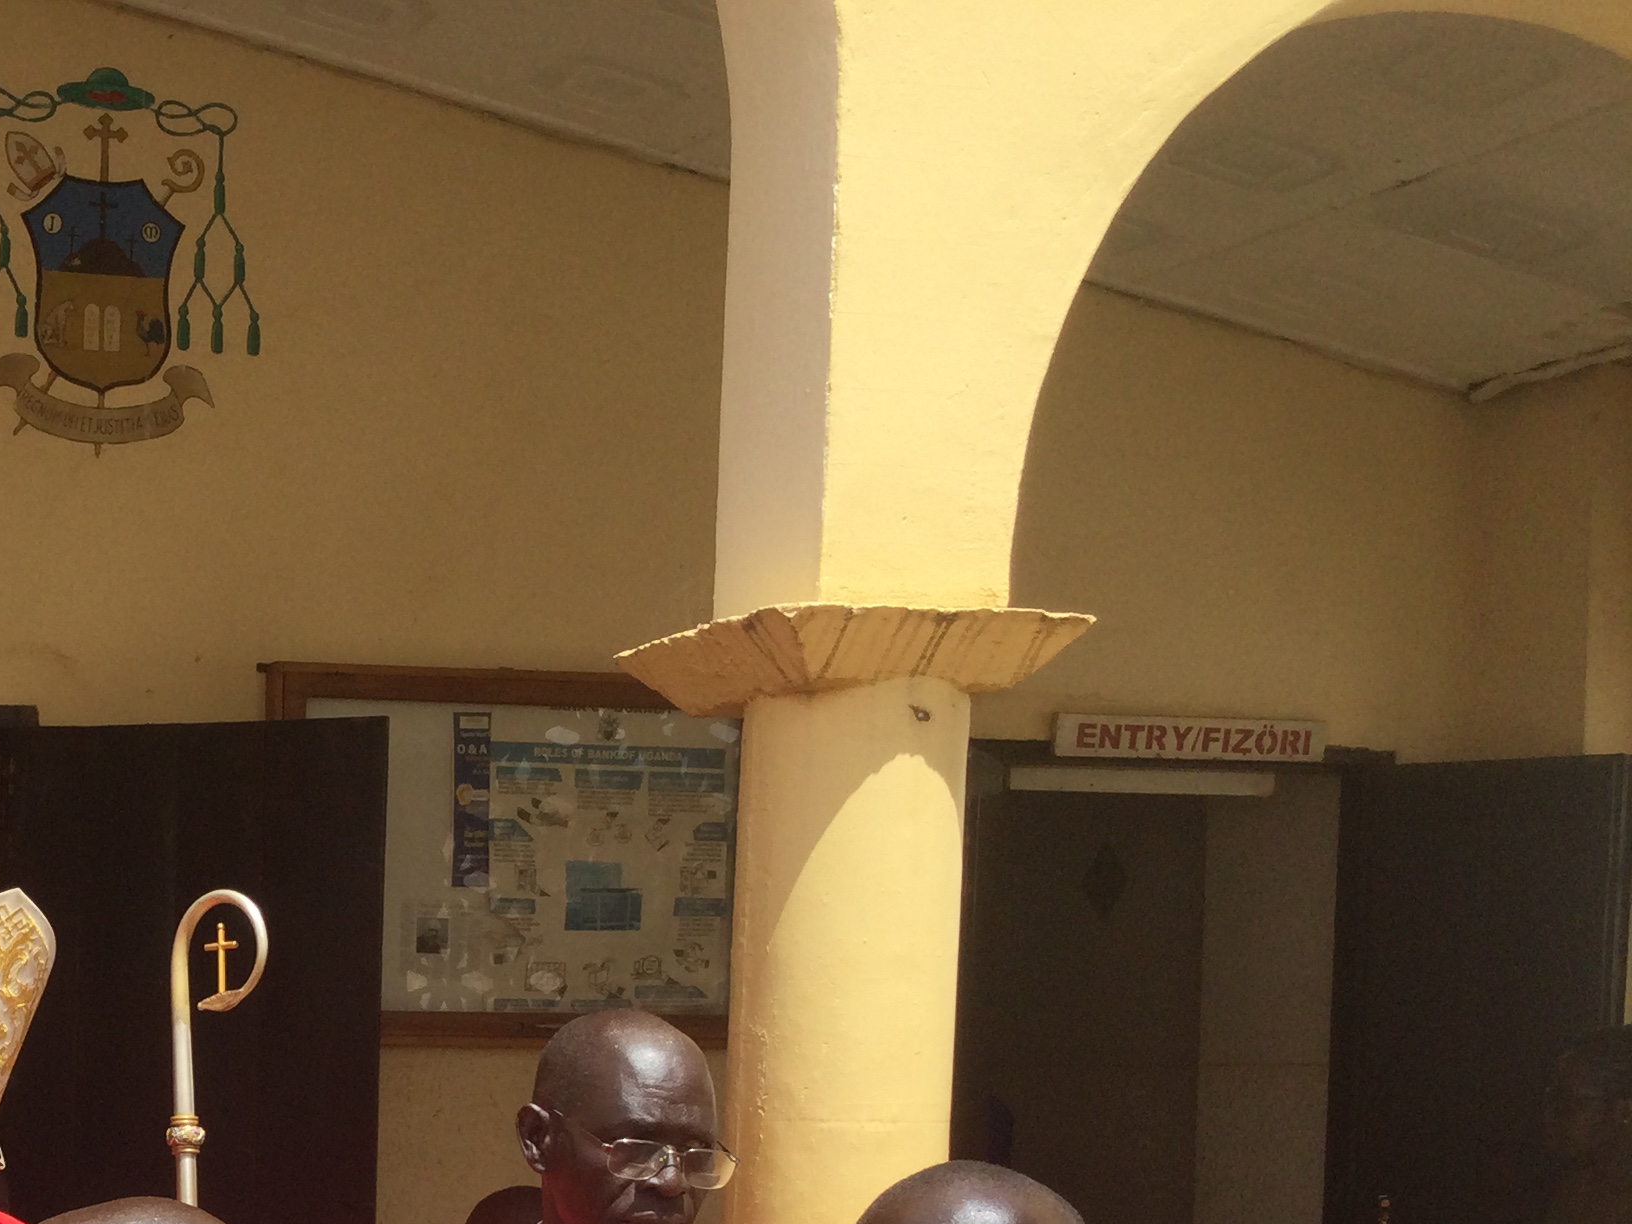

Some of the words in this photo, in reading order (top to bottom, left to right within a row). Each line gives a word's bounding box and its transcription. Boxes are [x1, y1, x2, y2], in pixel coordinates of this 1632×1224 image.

[1075, 722, 1313, 756] ENTRY/FIZÖRI
[533, 746, 568, 758] ROLES
[571, 747, 583, 759] OF
[587, 748, 618, 760] BANK
[619, 749, 635, 761] OF
[638, 749, 683, 762] UGANDA
